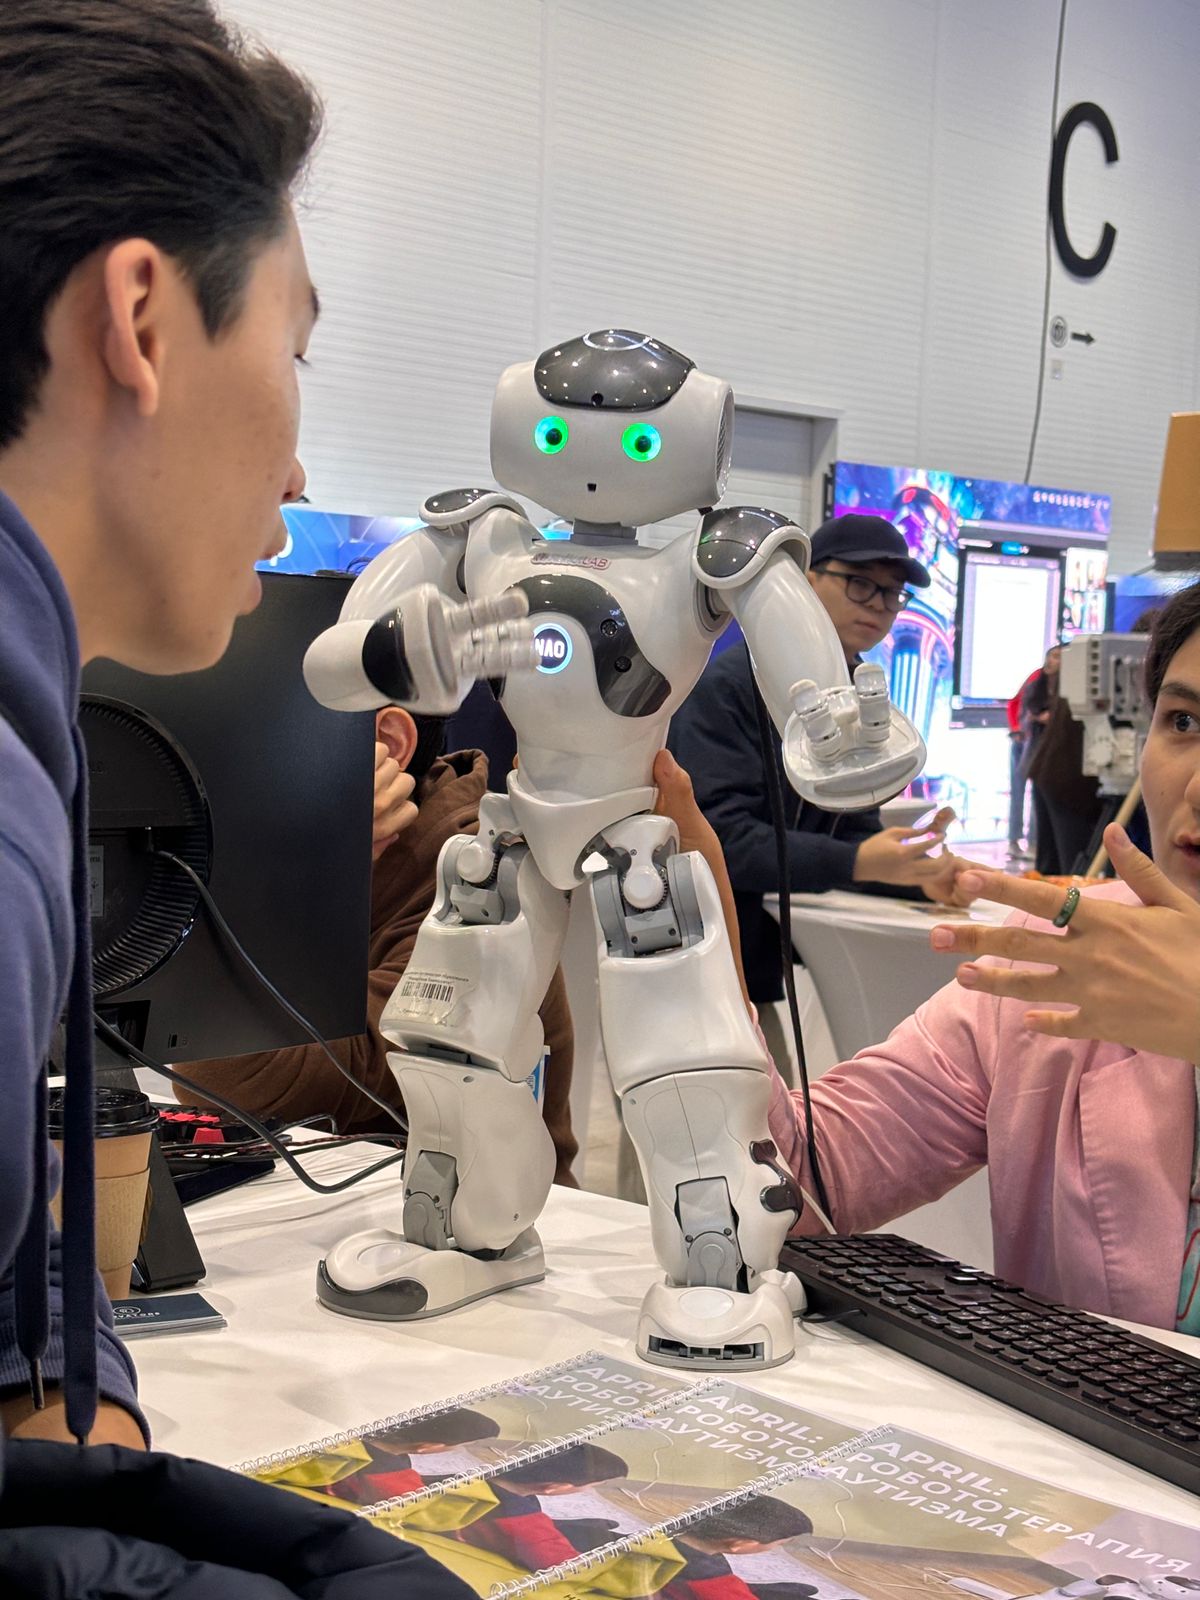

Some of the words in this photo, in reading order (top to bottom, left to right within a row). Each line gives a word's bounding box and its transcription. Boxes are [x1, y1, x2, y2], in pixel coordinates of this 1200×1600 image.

[1050, 102, 1119, 278] C
[534, 638, 565, 658] NAO
[525, 1384, 614, 1416] АУТИ
[552, 1374, 640, 1406] РОБО
[576, 1367, 670, 1397] APRI
[648, 1416, 798, 1470] АУТИЗМ
[674, 1404, 815, 1458] РОБОТО
[696, 1394, 824, 1444] APRIL:
[868, 1441, 1009, 1496] APRIL:
[821, 1465, 1008, 1538] АУТИЗМА
[845, 1452, 1193, 1573] РОБОТОТЕРАПИЯ
